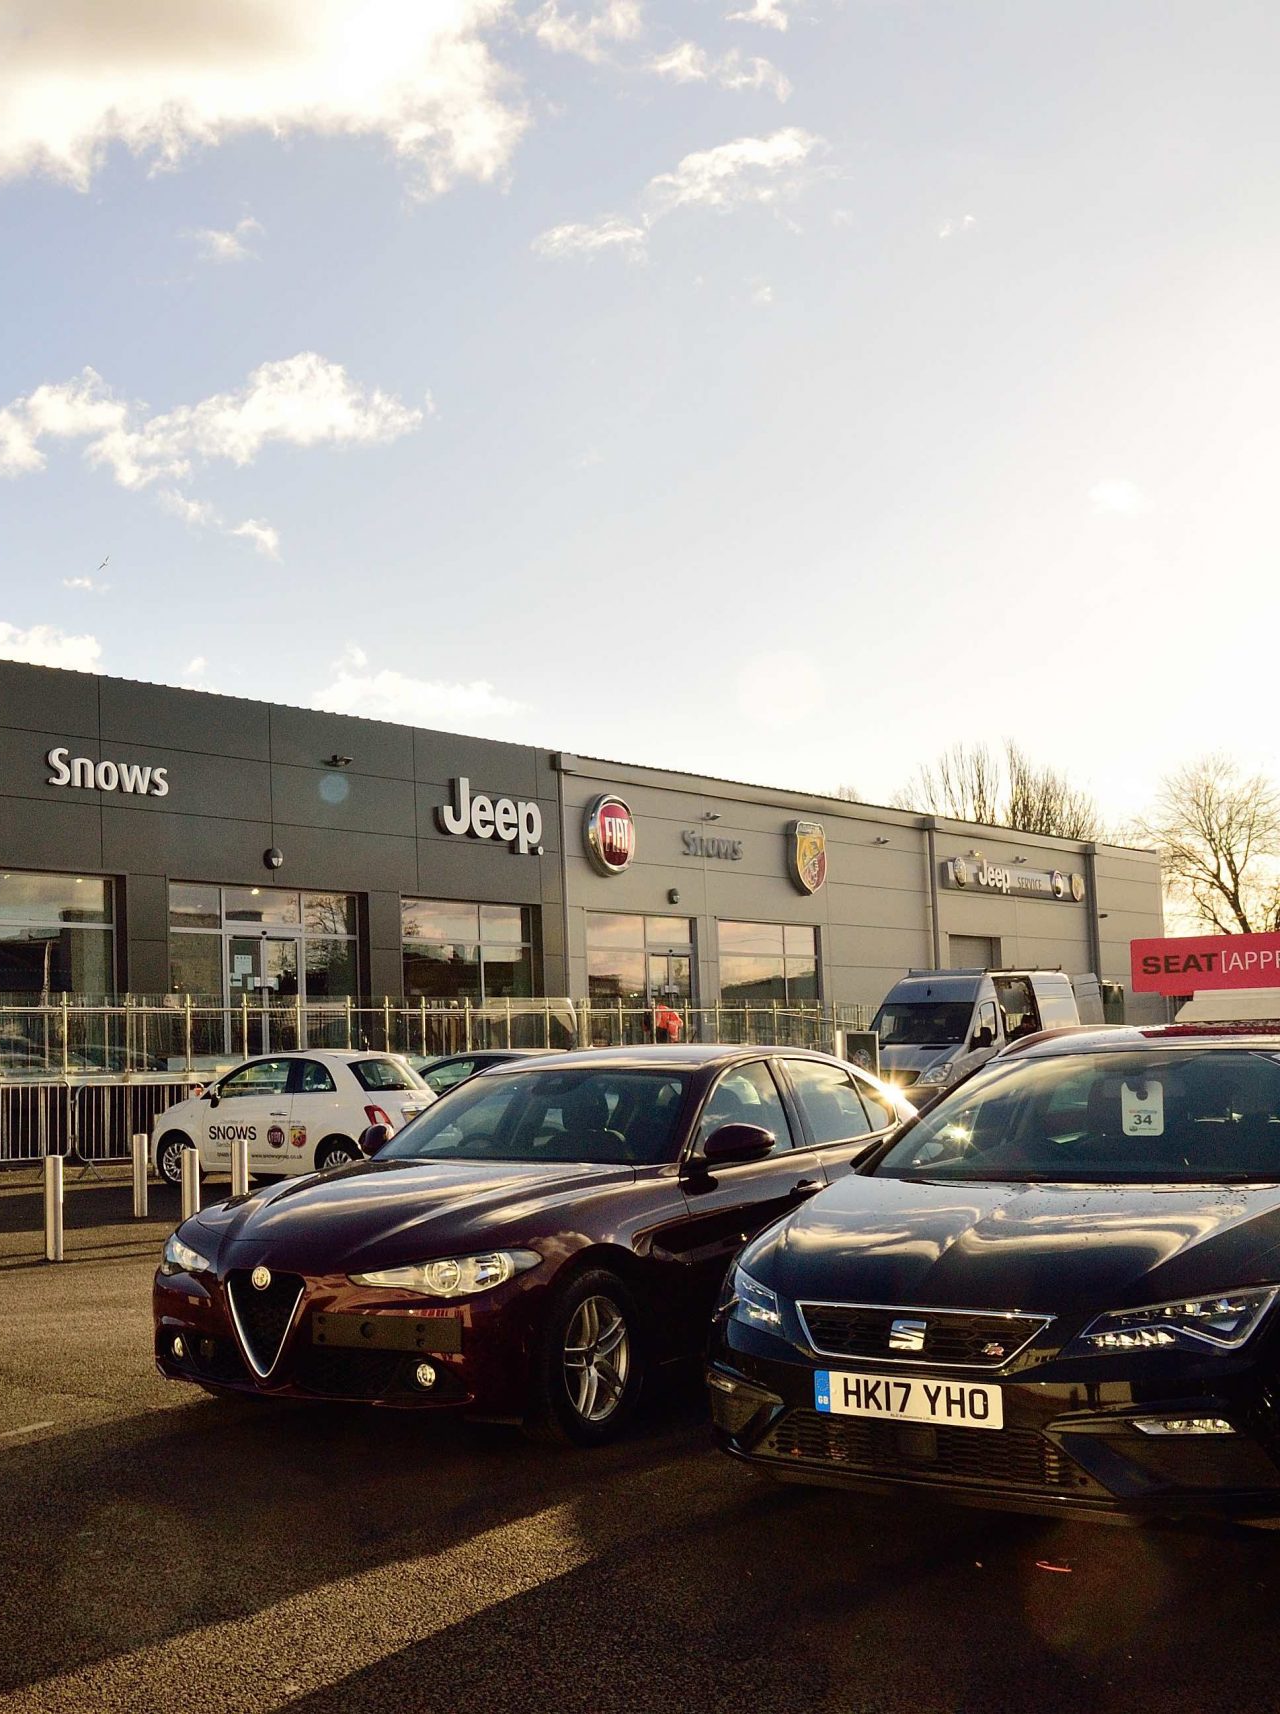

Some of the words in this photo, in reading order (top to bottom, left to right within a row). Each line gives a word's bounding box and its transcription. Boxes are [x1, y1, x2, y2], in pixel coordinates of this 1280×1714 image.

[46, 747, 170, 797] Snows
[604, 816, 630, 853] FIAT
[681, 830, 743, 861] Snows
[1017, 876, 1043, 892] SERVICE
[208, 1125, 257, 1141] SNOWS
[1133, 1113, 1153, 1126] 34
[843, 1377, 912, 1413] HK17
[923, 1384, 989, 1420] YHO
